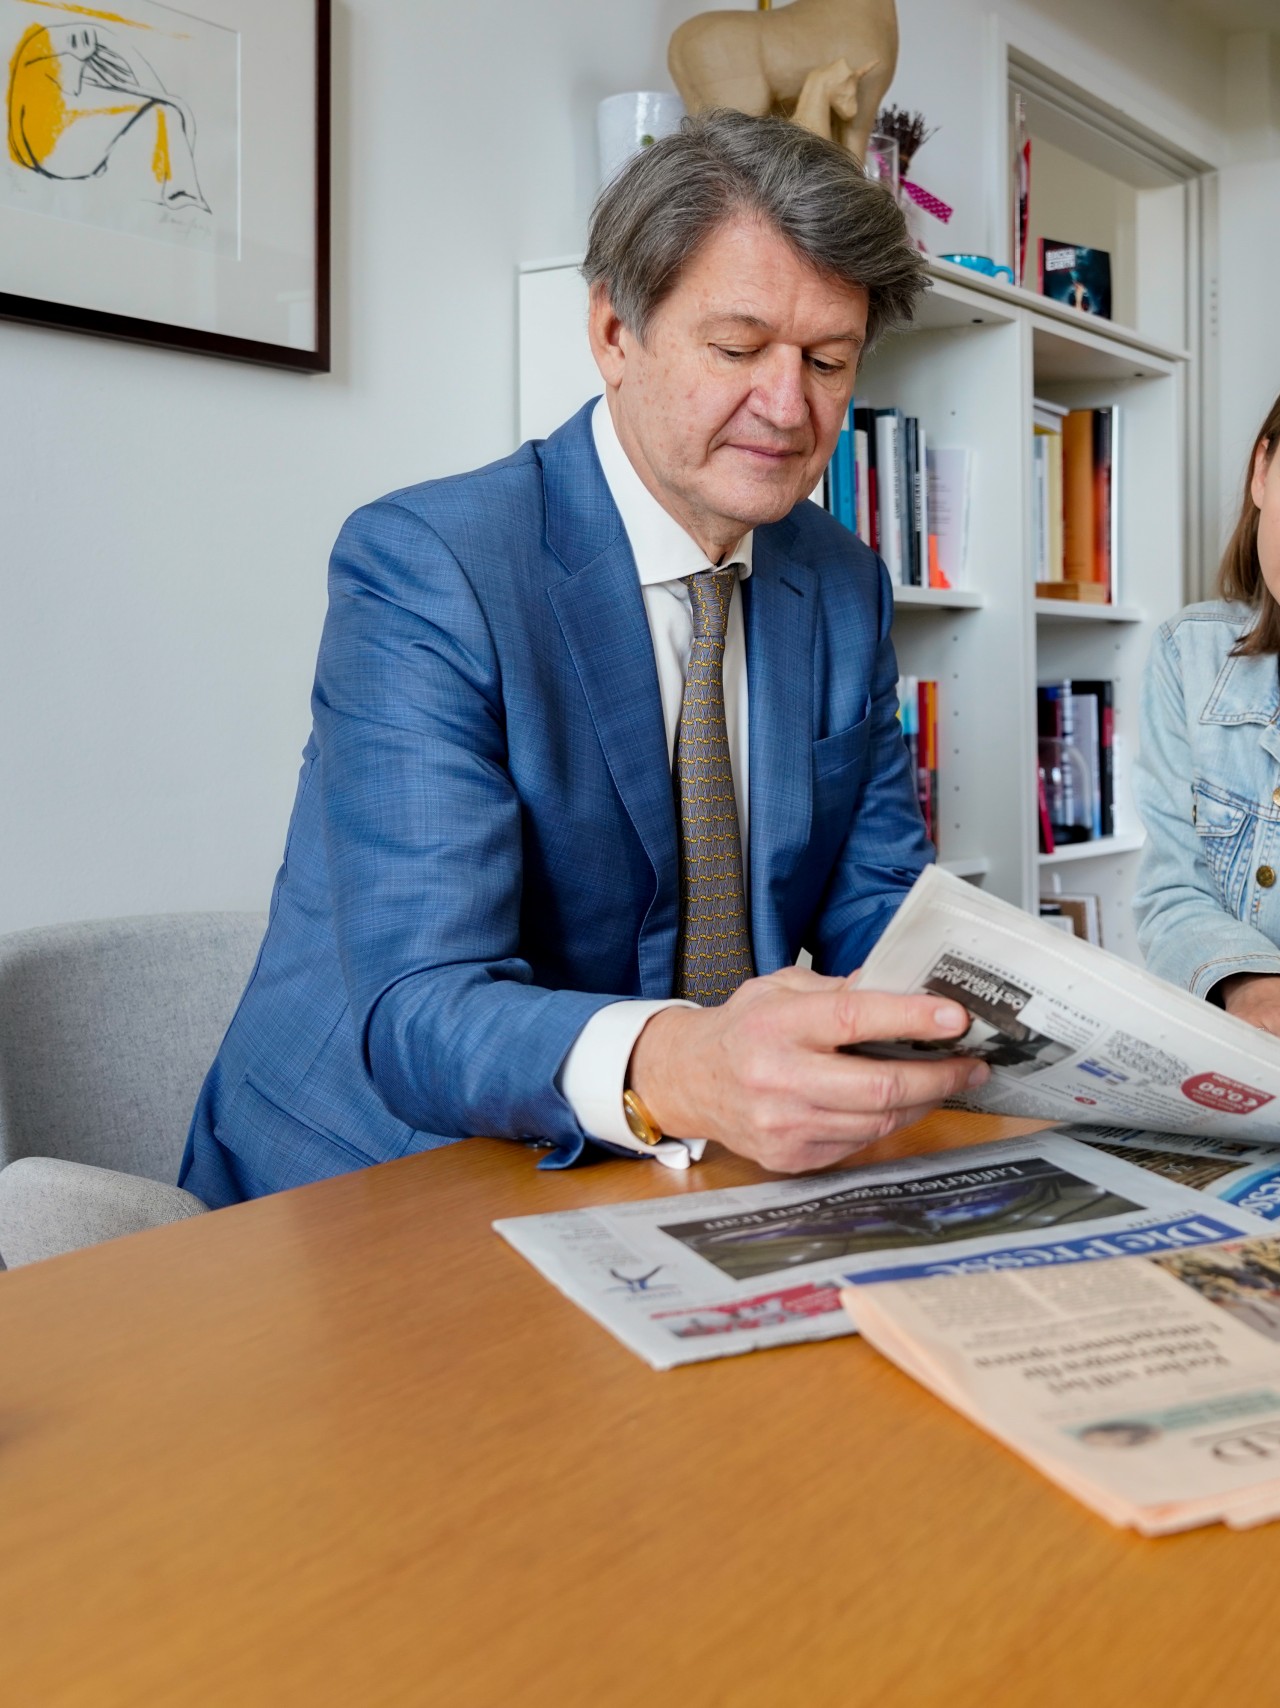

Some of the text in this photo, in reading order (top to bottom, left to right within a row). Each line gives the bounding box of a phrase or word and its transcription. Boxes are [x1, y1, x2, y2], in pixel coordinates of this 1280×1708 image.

[931, 969, 1001, 1006] LUST AUF
[935, 962, 1025, 1011] ÖSTERREICH
[1198, 1081, 1244, 1102] 0,90
[1242, 1097, 1258, 1107] €
[703, 1165, 1025, 1232] Luftkrieg gegen den Iran
[1115, 1220, 1227, 1250] Die
